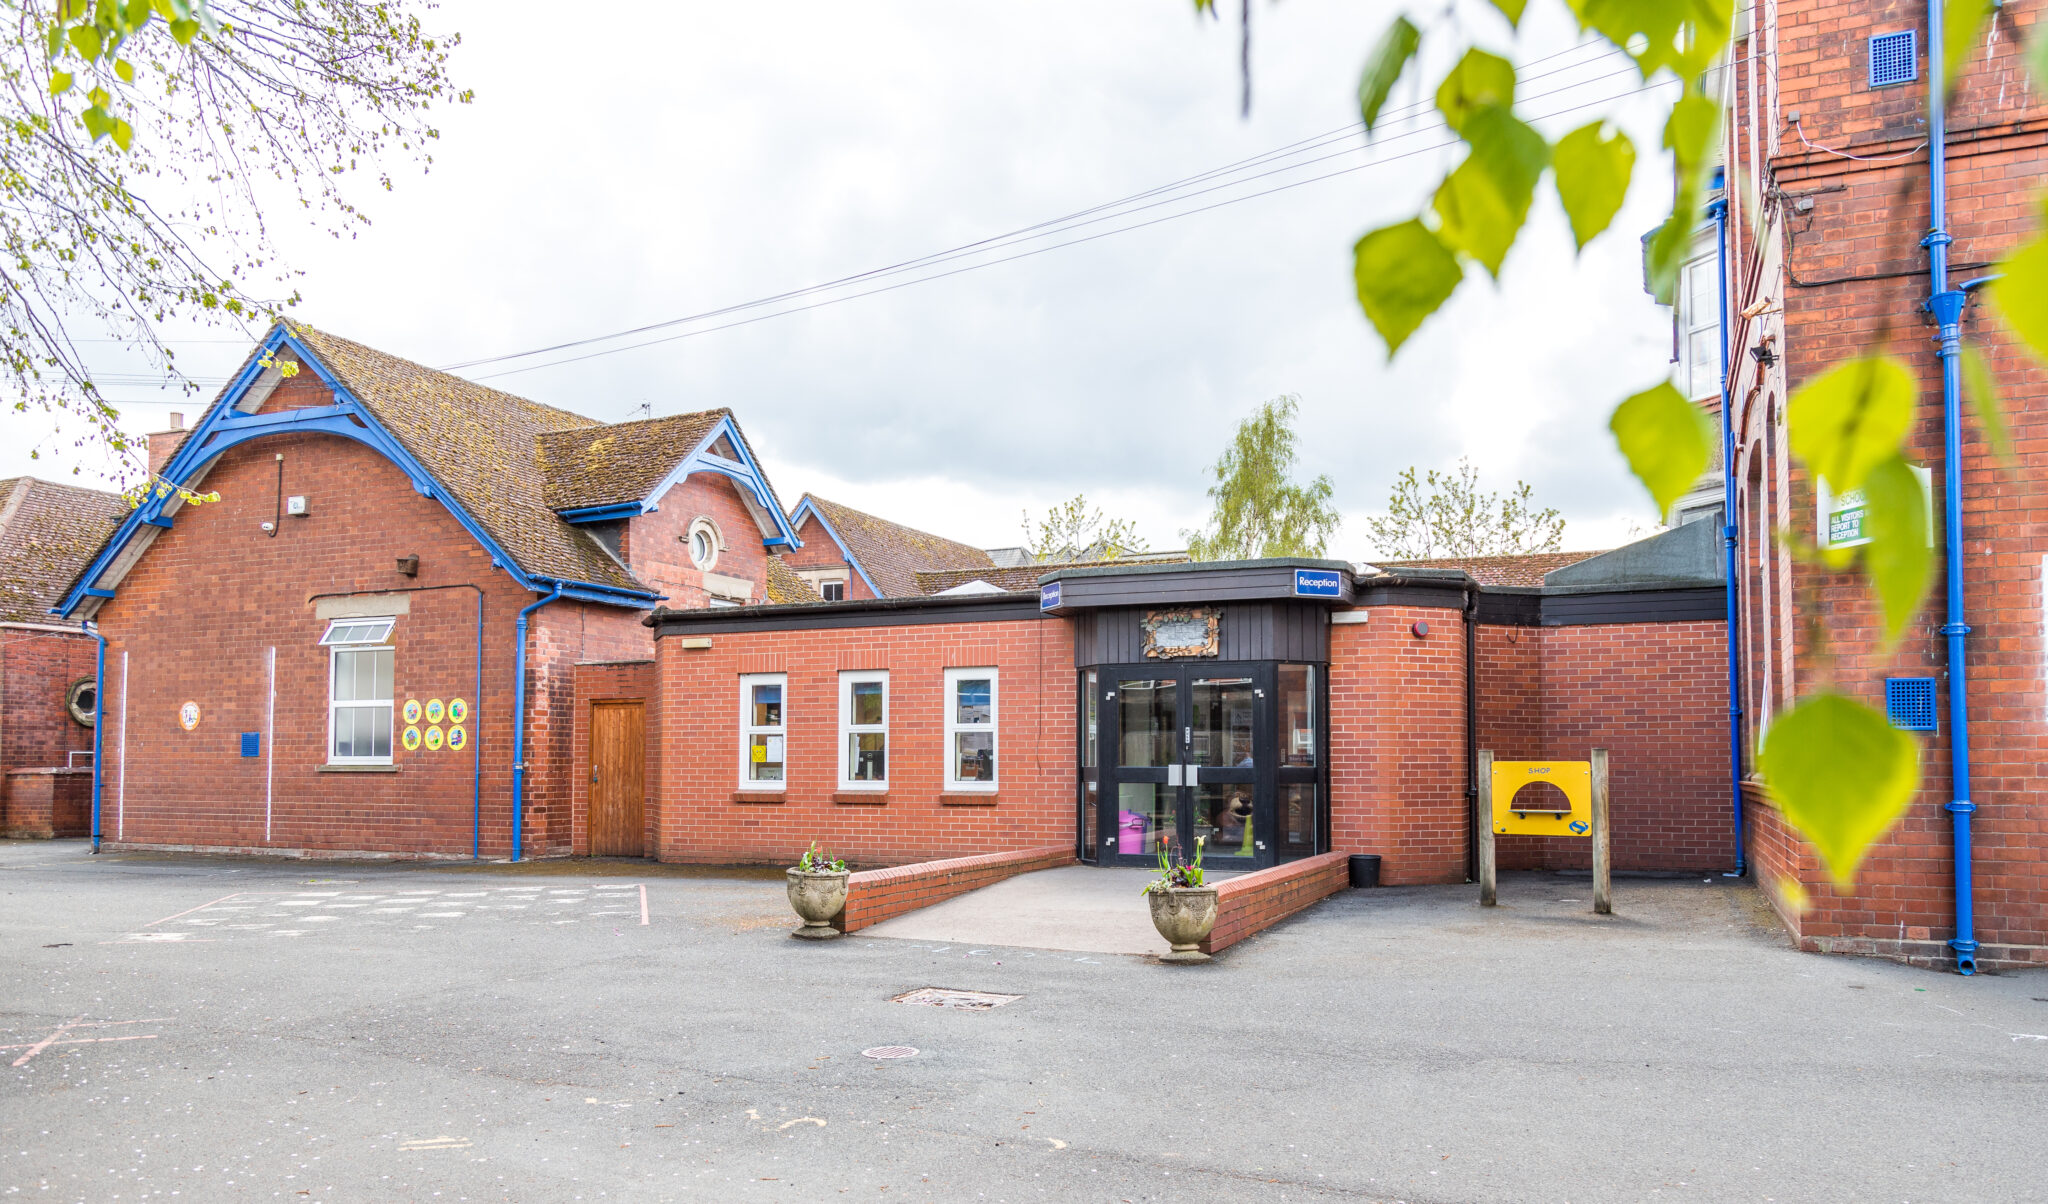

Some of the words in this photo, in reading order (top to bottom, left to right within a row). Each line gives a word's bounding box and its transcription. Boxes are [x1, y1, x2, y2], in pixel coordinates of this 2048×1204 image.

[1831, 515, 1840, 524] ALL
[1841, 509, 1864, 522] VISITORS
[1831, 521, 1850, 532] REPORT
[1852, 519, 1859, 528] TO
[1831, 528, 1859, 541] RECEPTION
[1299, 576, 1337, 589] Reception
[1043, 590, 1058, 600] Reception
